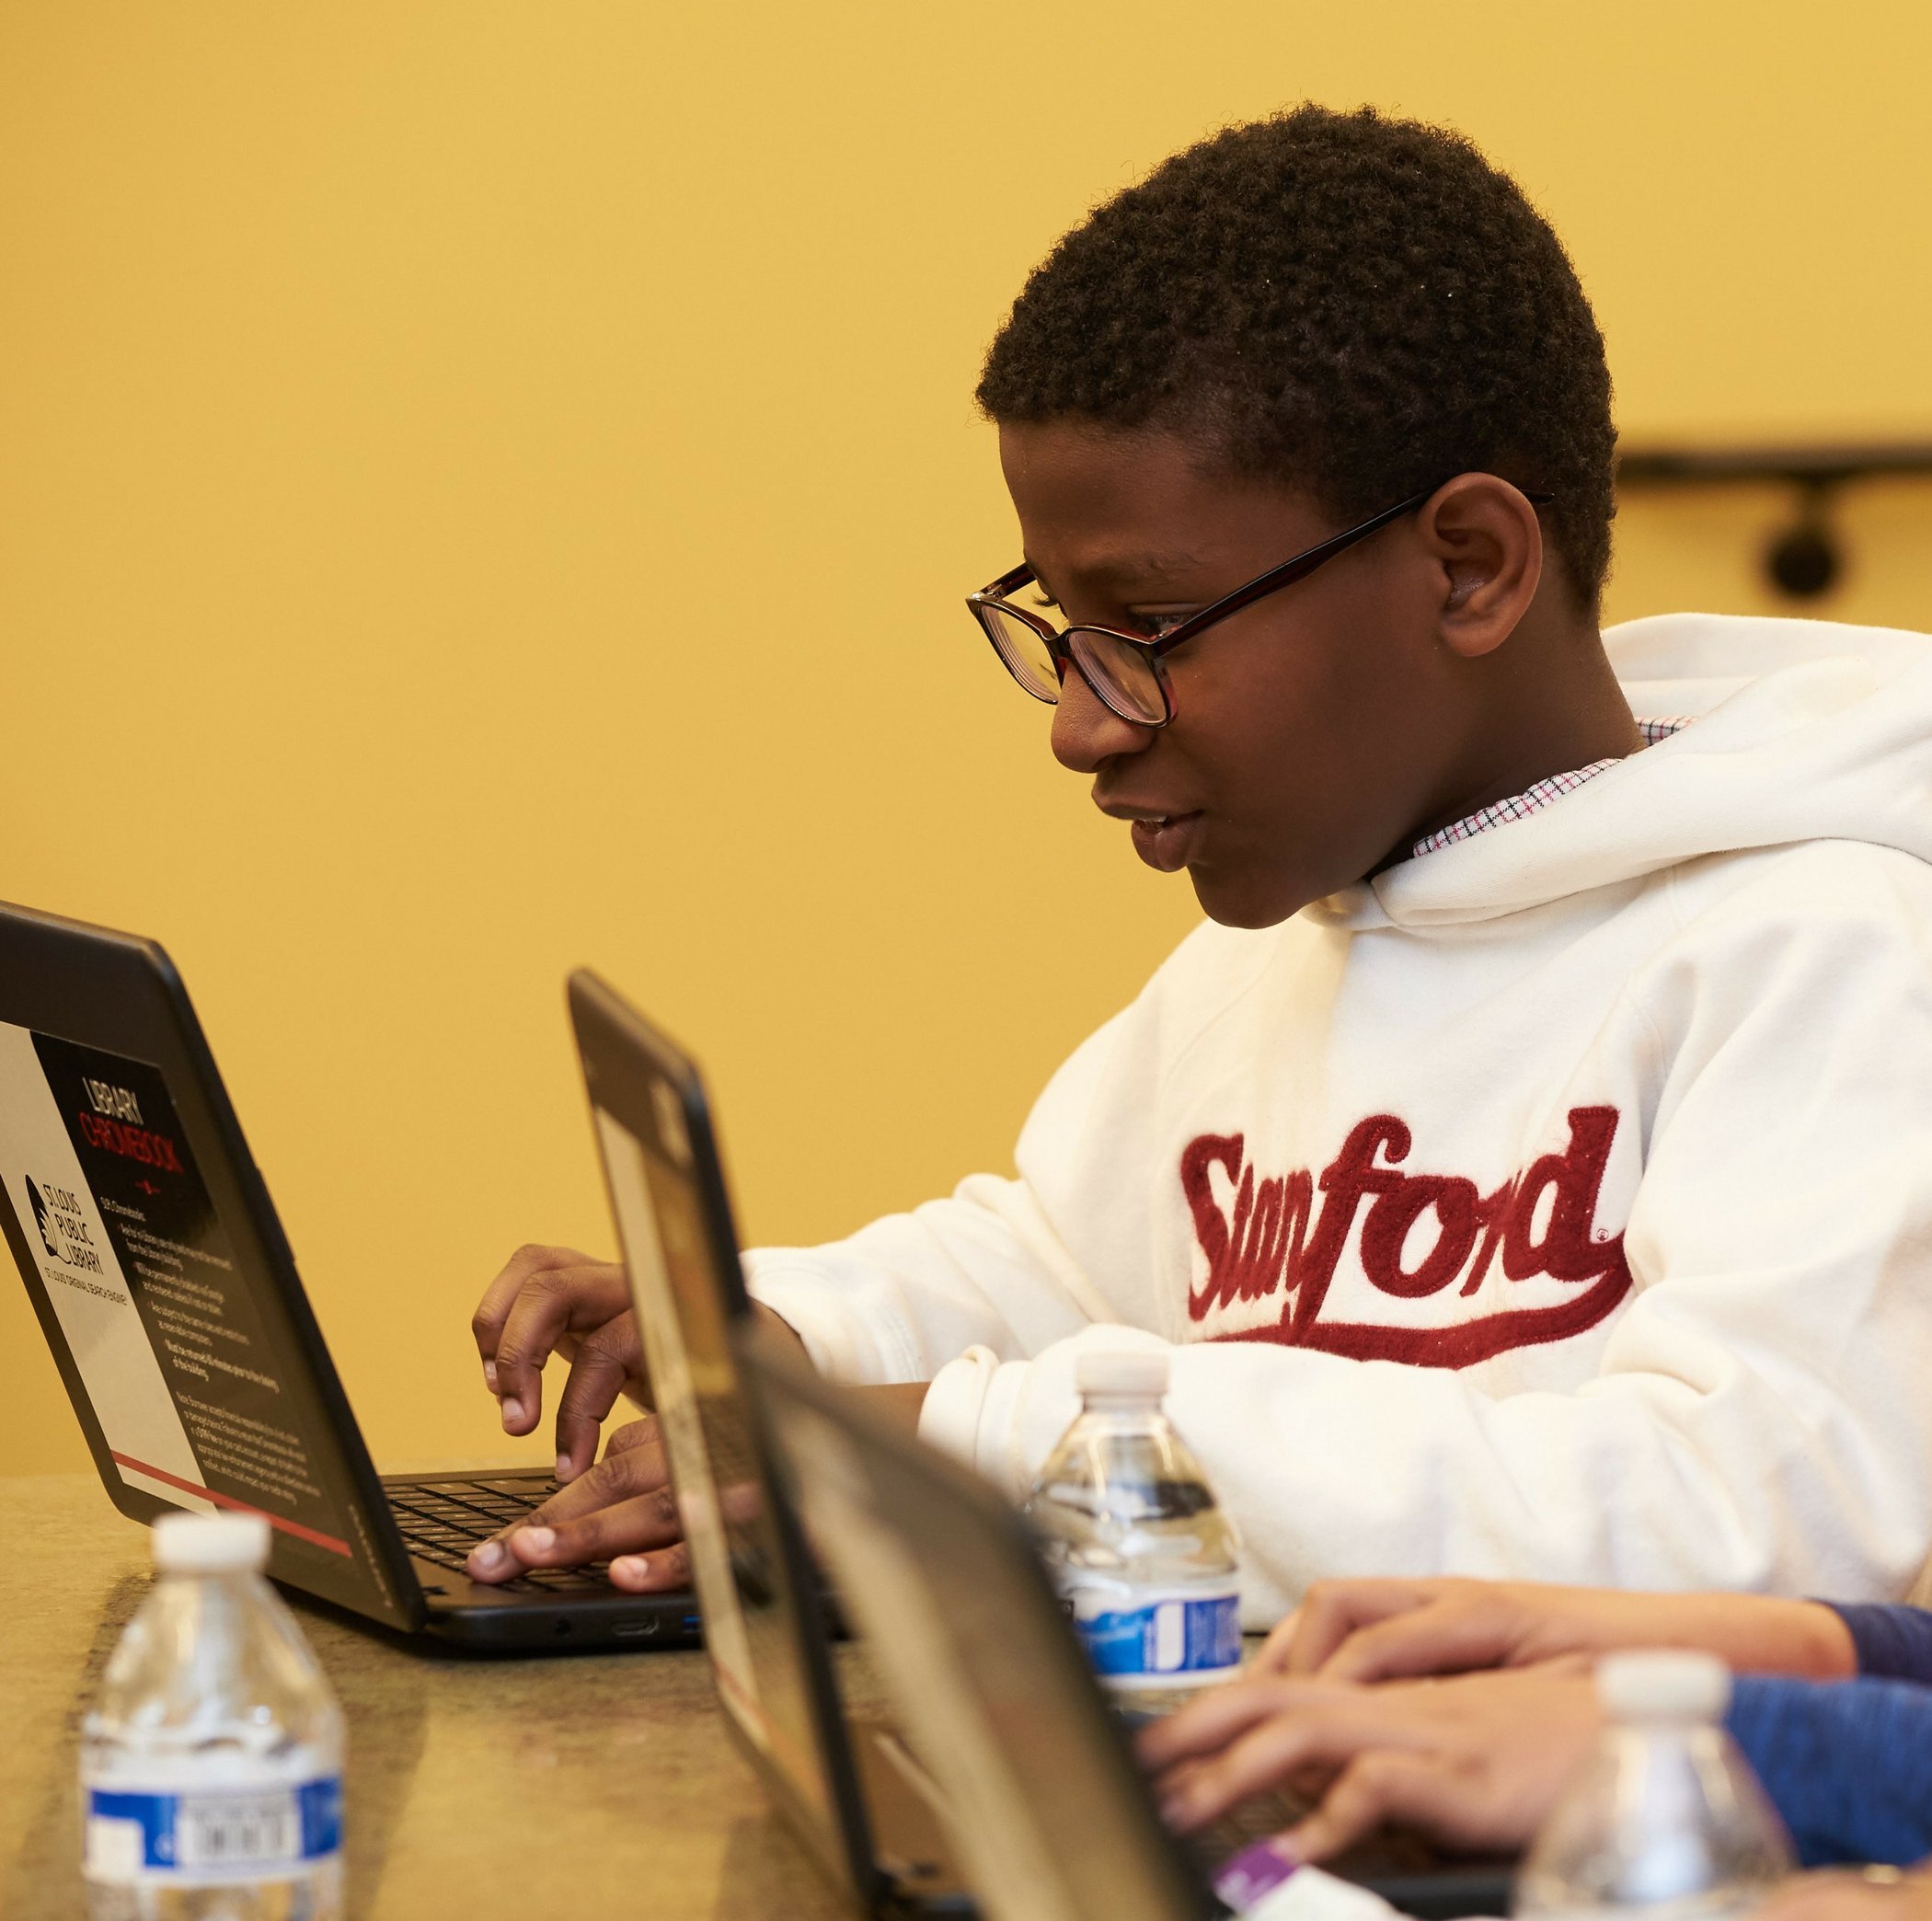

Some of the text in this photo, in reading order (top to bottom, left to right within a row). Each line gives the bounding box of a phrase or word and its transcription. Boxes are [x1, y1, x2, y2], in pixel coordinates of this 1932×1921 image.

[82, 1076, 144, 1125] LIBRARY
[79, 1110, 185, 1175] CHROMEBOOK
[43, 1183, 82, 1216] ST. LOUIS
[54, 1213, 95, 1246] PUBLIC
[1180, 1106, 1628, 1345] Stanford
[65, 1242, 104, 1276] LIBRARY
